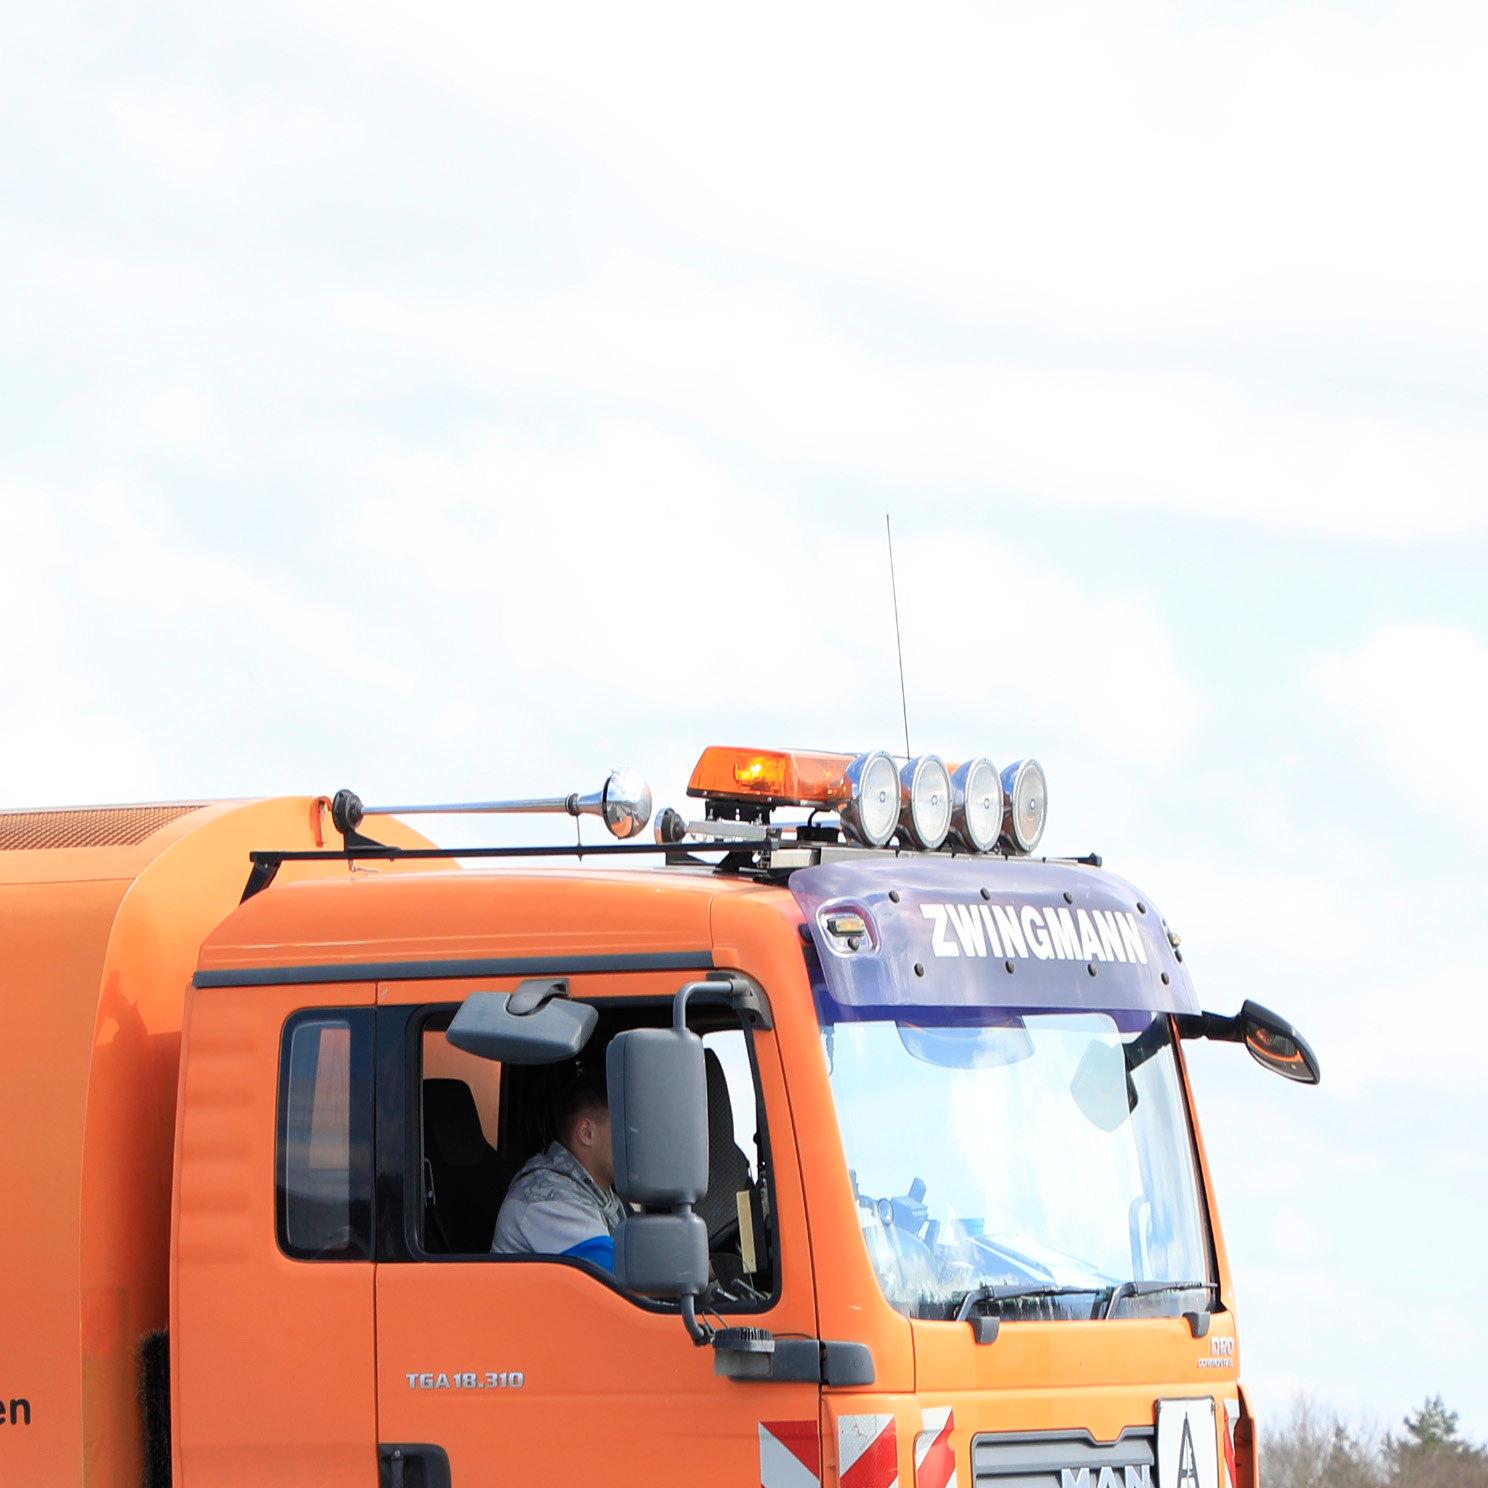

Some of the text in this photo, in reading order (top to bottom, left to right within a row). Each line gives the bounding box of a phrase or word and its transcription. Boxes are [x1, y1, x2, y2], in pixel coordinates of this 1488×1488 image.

[919, 904, 1148, 965] ZWINGMANN
[405, 1372, 525, 1390] TGA 18.310
